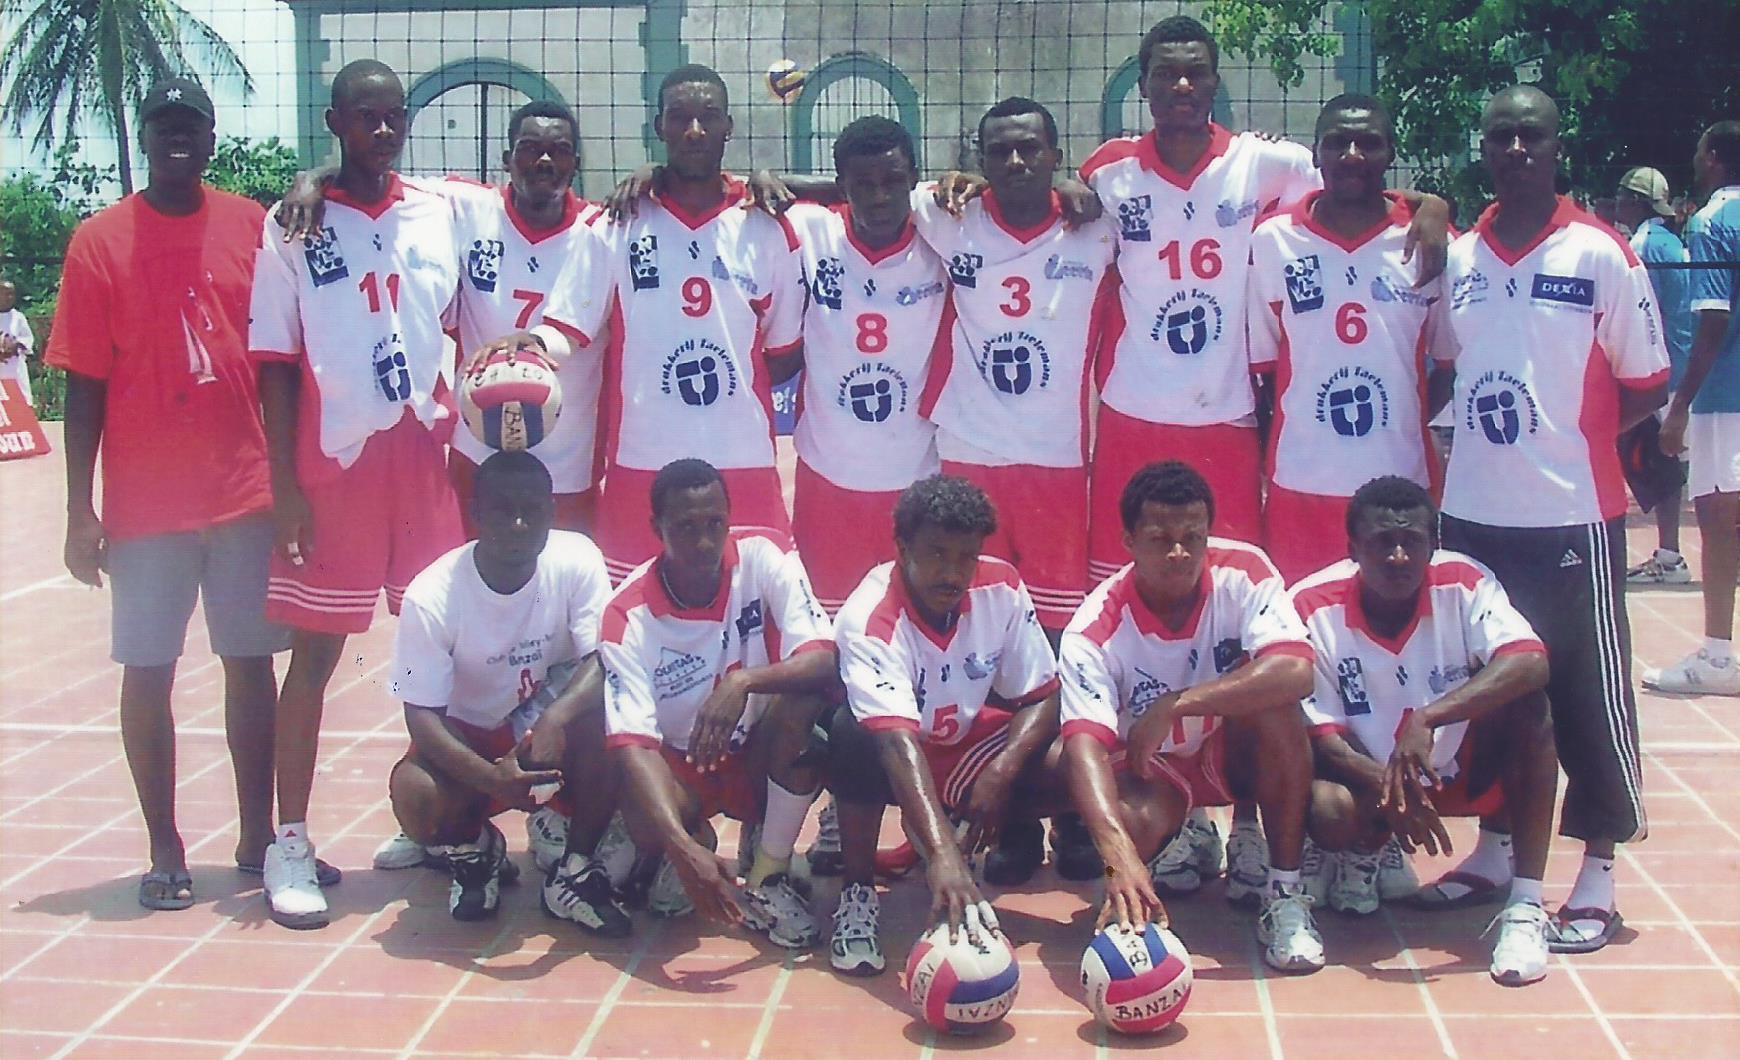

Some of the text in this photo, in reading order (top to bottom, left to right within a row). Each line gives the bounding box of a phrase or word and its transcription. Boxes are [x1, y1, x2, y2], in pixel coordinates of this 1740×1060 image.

[1158, 238, 1222, 280] 16
[359, 271, 401, 313] 11
[513, 289, 544, 329] 7
[682, 276, 712, 318] 9
[1000, 276, 1031, 318] 3
[1542, 282, 1585, 297] DEXIA
[856, 313, 888, 353] 8
[1335, 302, 1368, 345] 6
[930, 703, 960, 743] 5
